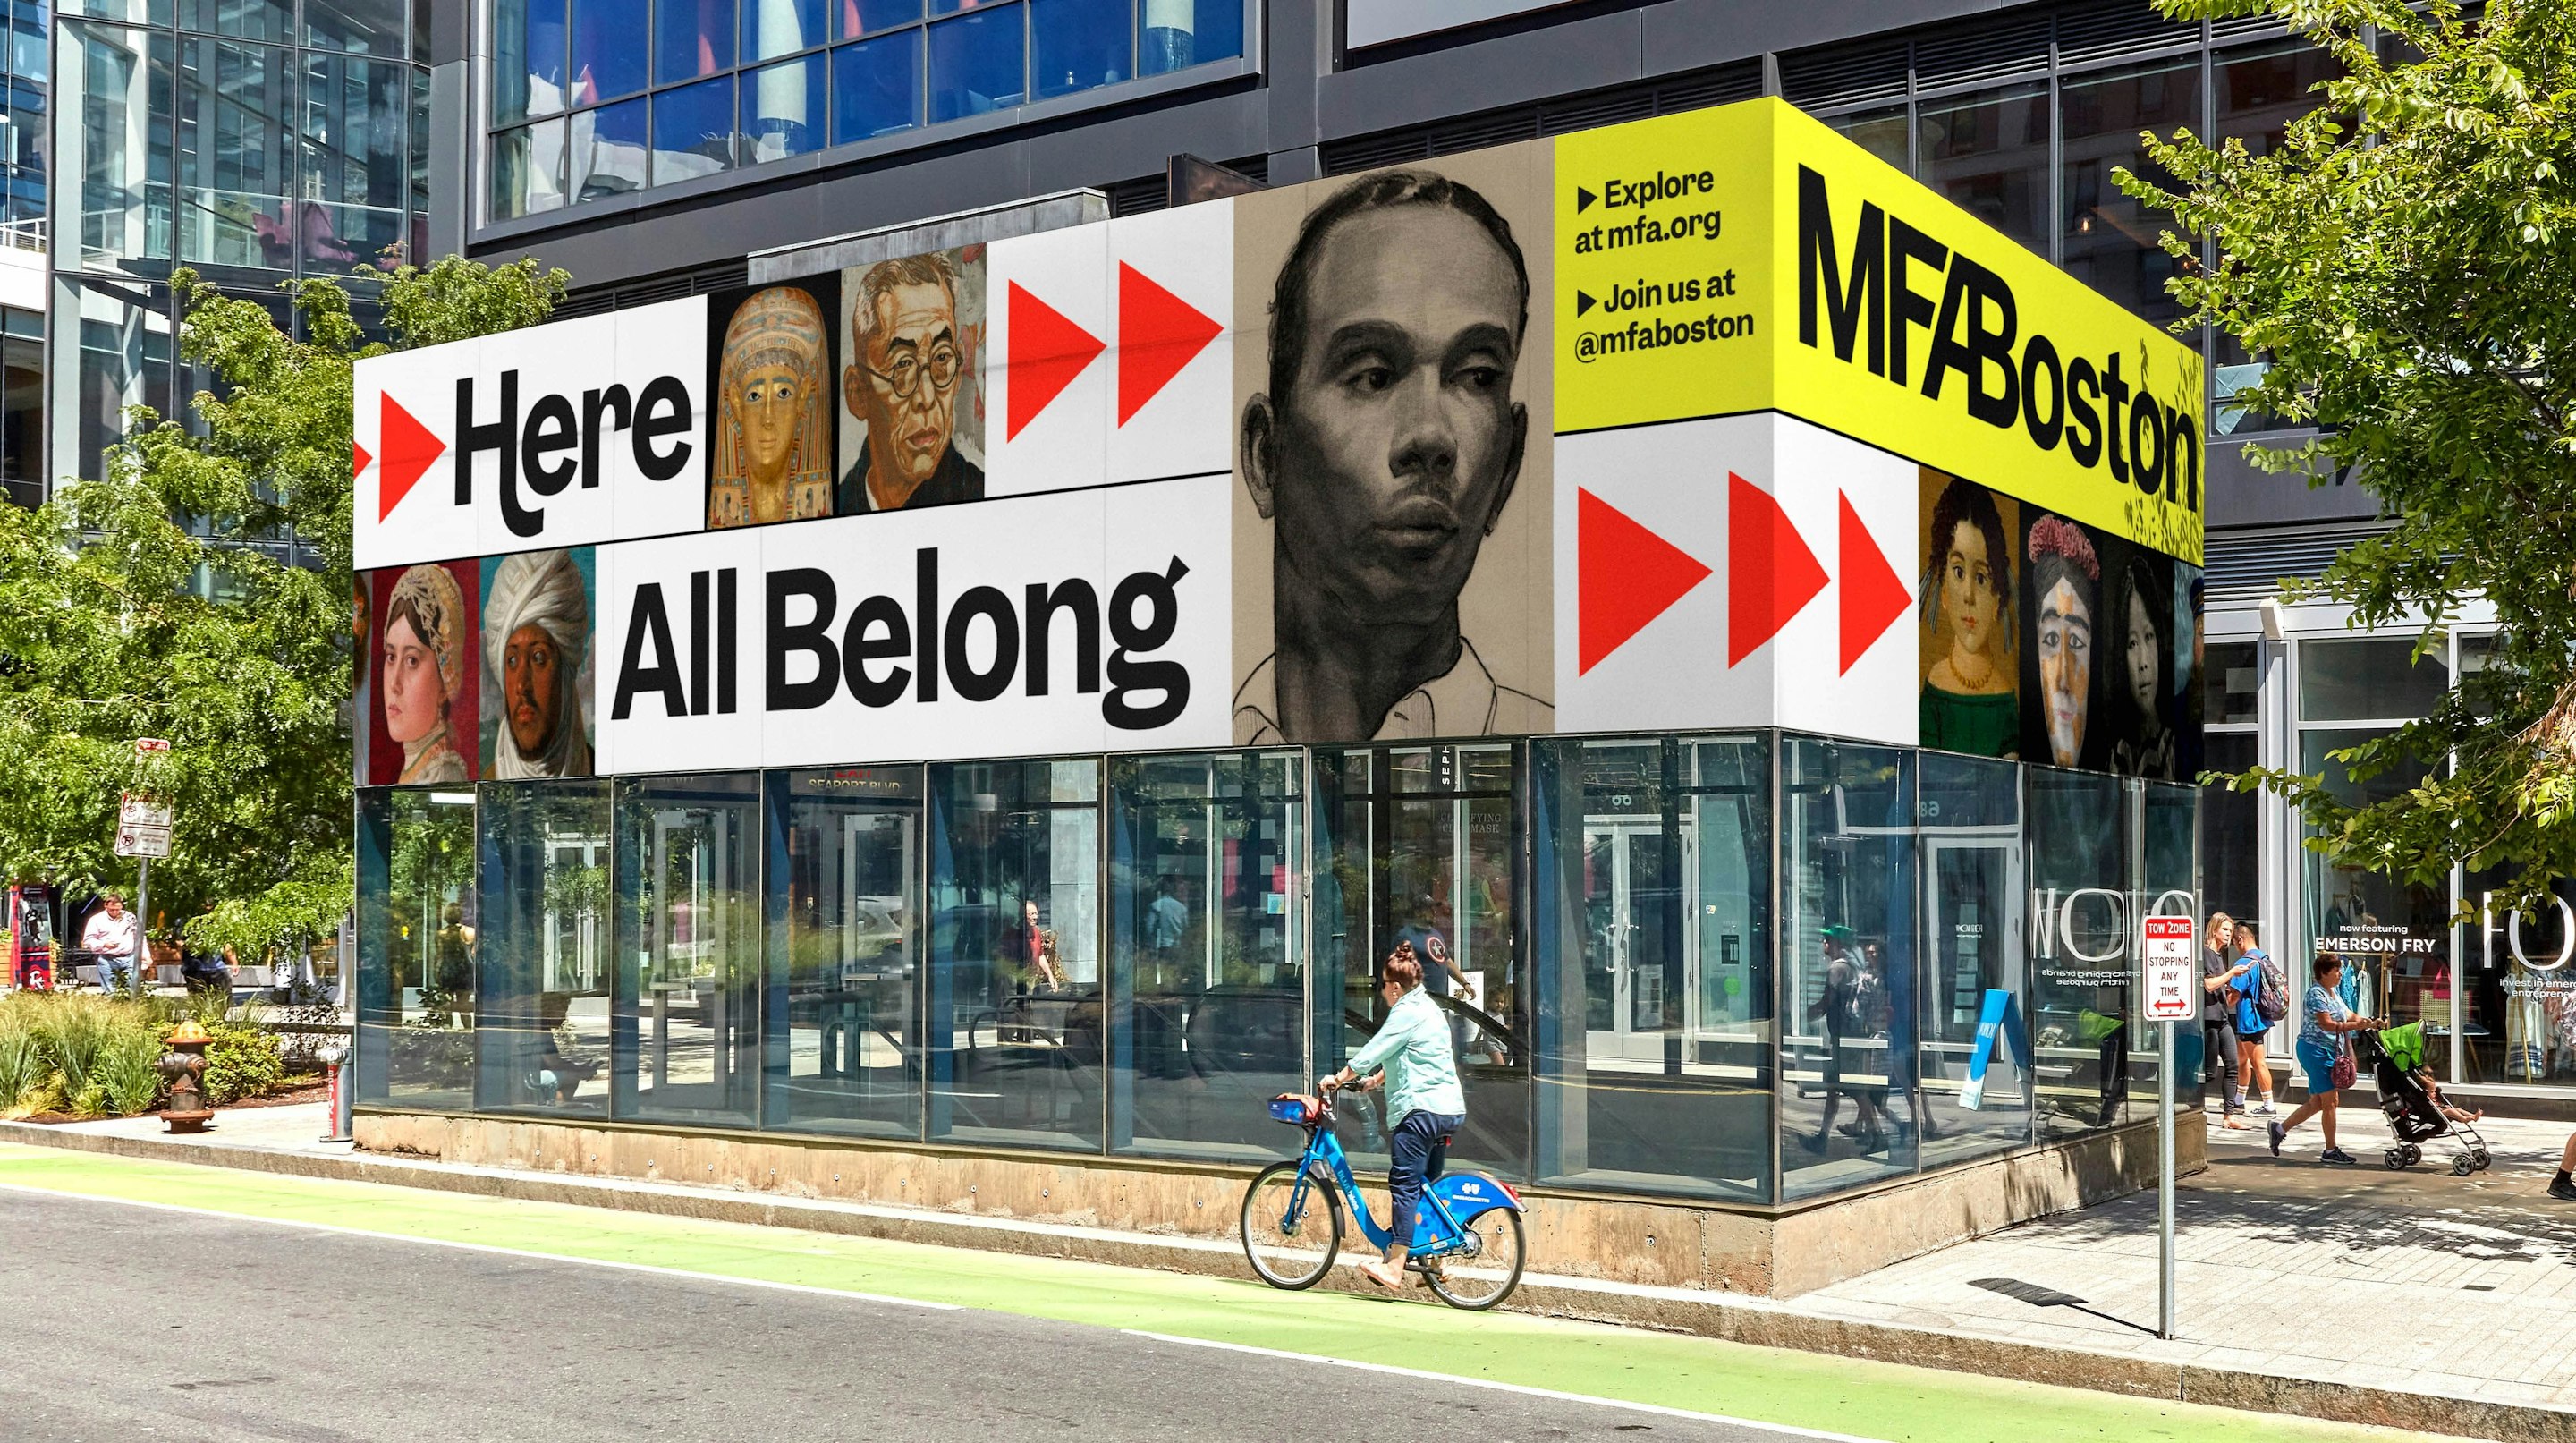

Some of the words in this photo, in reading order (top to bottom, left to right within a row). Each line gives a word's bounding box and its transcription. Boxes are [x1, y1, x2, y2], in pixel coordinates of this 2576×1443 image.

[1605, 170, 1715, 210] Explore
[1574, 225, 1604, 254] at
[1607, 210, 1721, 250] mfa.org
[1604, 278, 1662, 313] Join
[1667, 278, 1701, 304] us
[1706, 268, 1736, 299] at
[1574, 313, 1754, 364] @mfaboston
[454, 369, 693, 538] Here
[611, 567, 737, 720] All
[766, 547, 1191, 730] Belong
[2148, 922, 2165, 934] TOW
[2339, 925, 2360, 933] now
[2361, 924, 2409, 935] featuring
[2164, 942, 2175, 952] NO
[2315, 937, 2396, 952] EMERSON
[2402, 938, 2436, 953] FRY
[2148, 956, 2189, 967] STOPPING
[2160, 972, 2179, 981] ANY
[2499, 978, 2532, 987] invest
[2533, 978, 2544, 988] in
[2160, 986, 2180, 997] TIME
